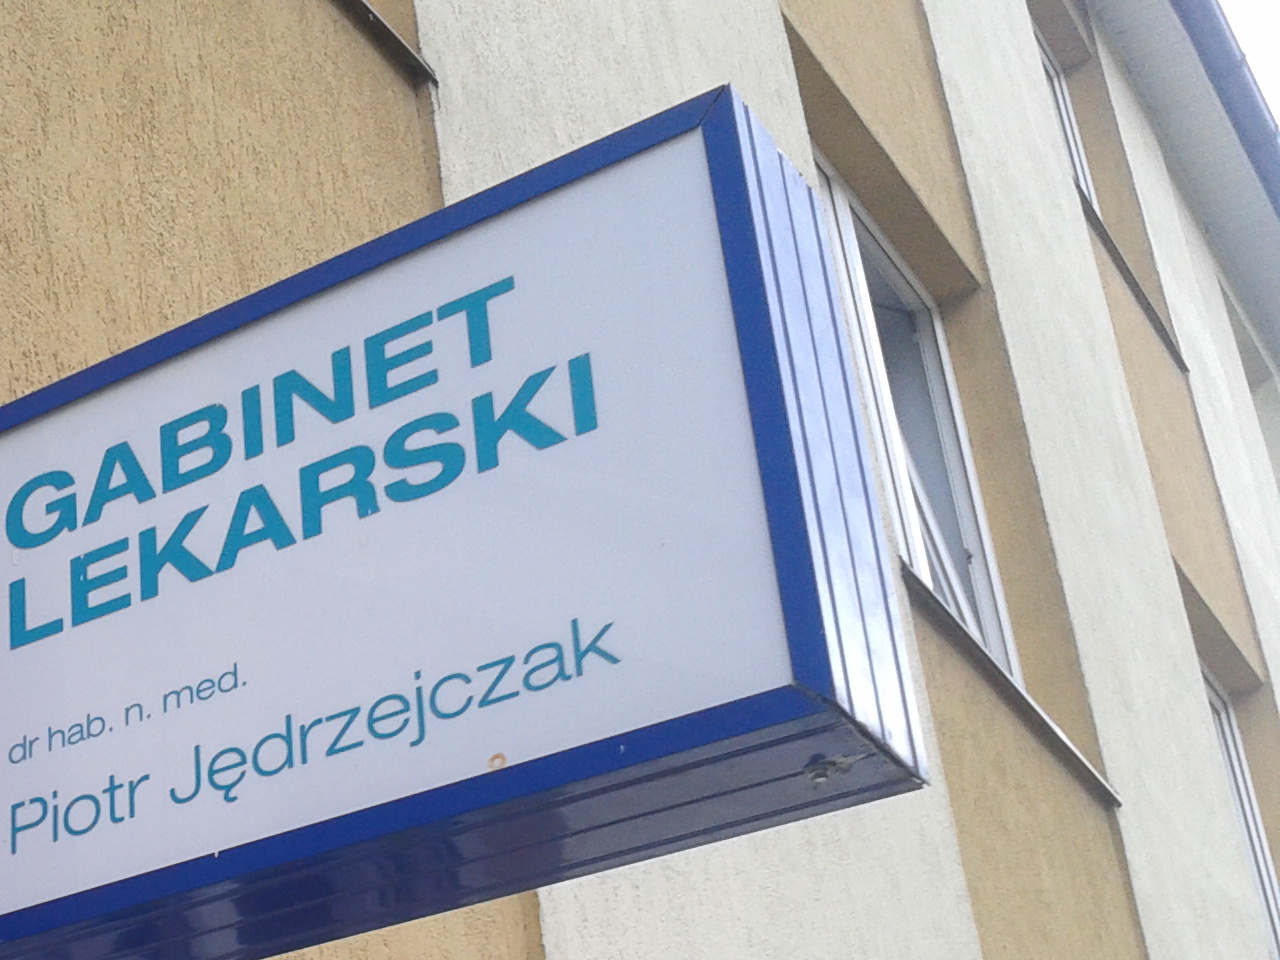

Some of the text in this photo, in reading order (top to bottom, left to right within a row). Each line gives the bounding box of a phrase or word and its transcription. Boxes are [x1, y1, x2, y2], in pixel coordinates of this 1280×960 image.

[5, 275, 516, 551] GABINET
[7, 352, 599, 651] LEKARSKI
[8, 662, 248, 765] dr hab. n. med.
[10, 617, 623, 856] Piotr Jędrzejczak
